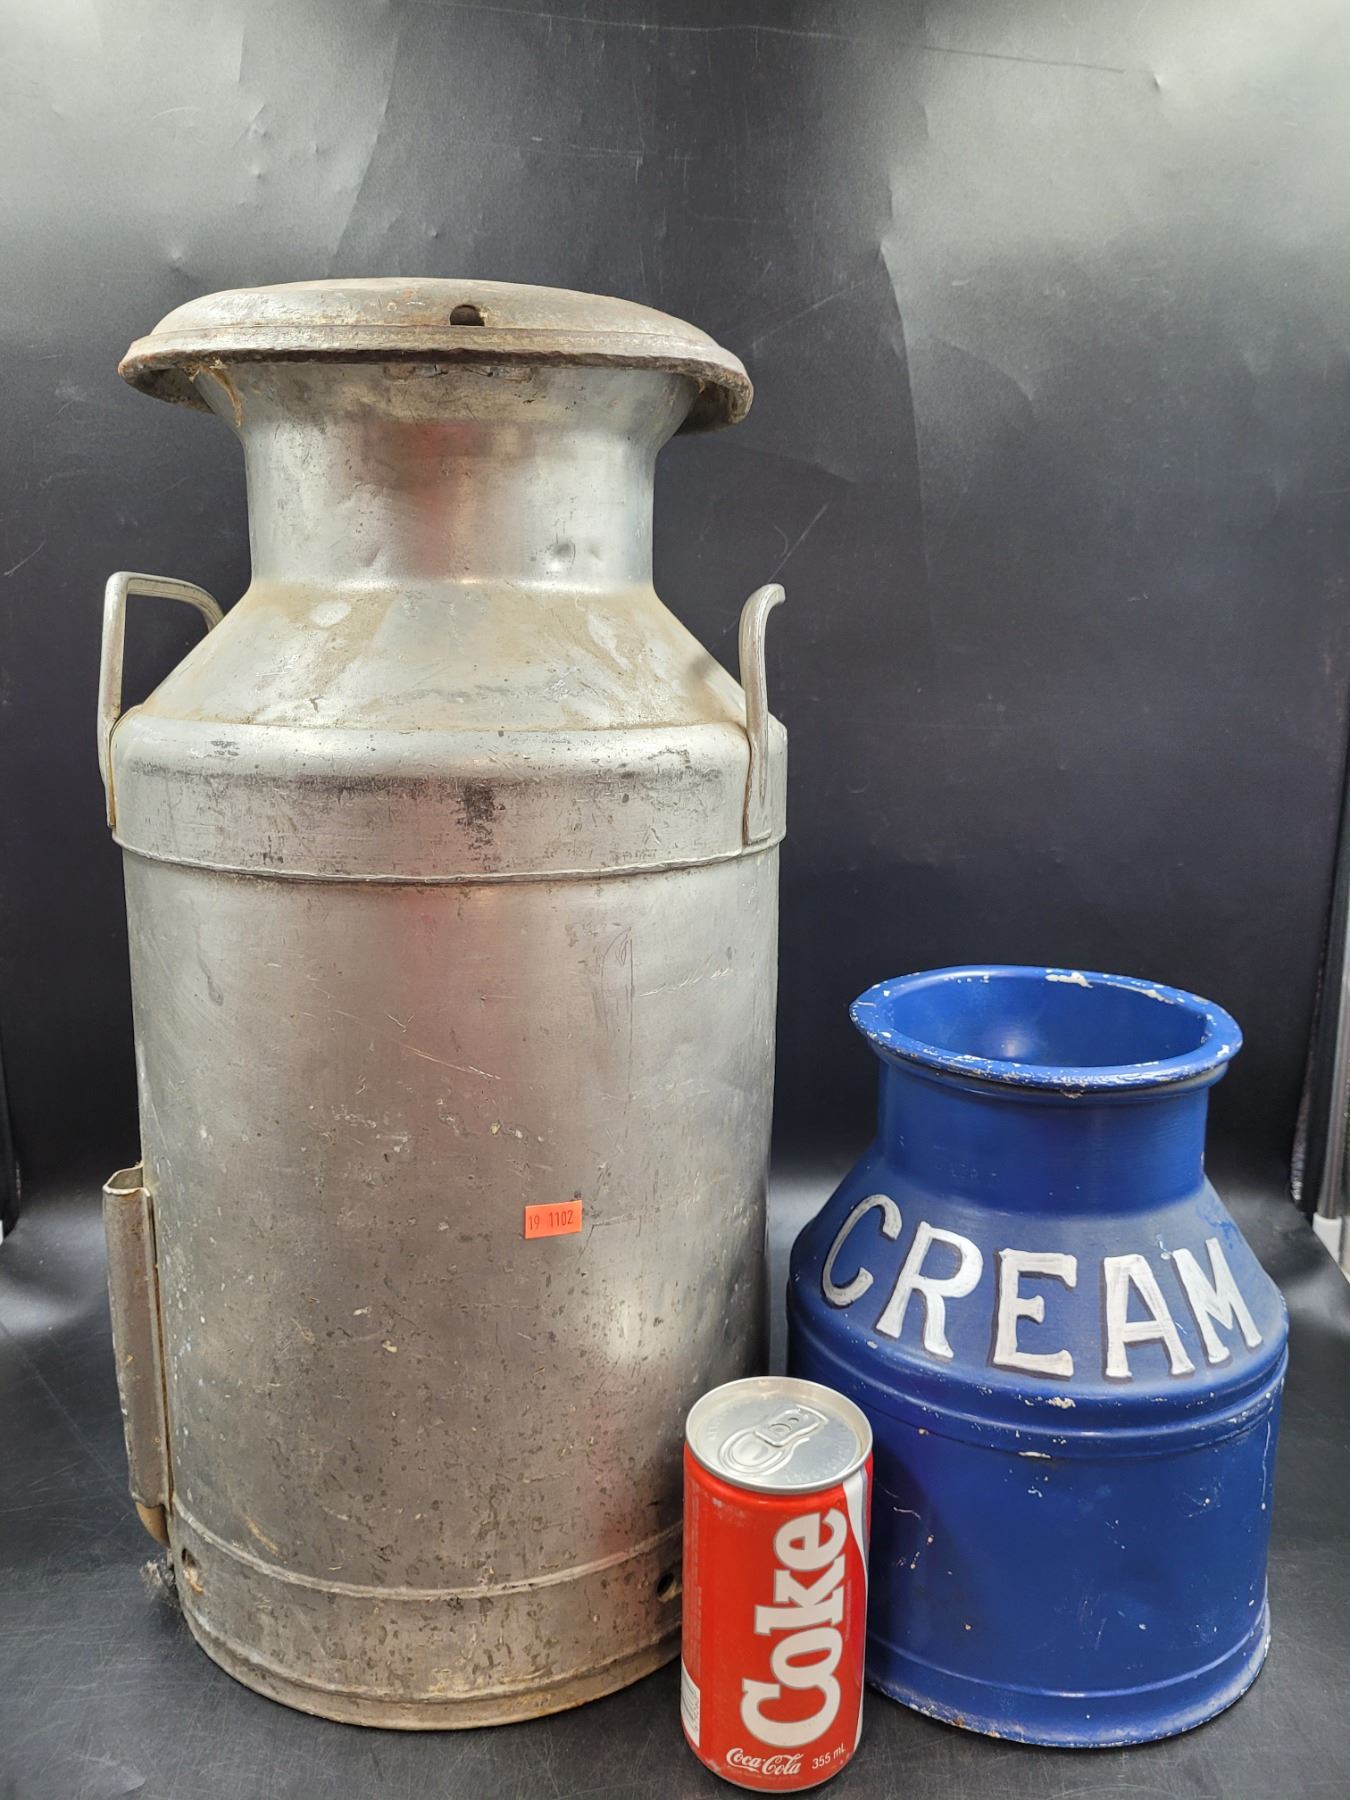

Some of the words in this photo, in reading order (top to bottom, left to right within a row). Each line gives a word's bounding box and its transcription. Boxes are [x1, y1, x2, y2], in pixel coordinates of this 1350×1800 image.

[528, 1214, 541, 1231] 19
[548, 1209, 575, 1228] 1102
[822, 1193, 1263, 1379] CREAM
[739, 1507, 848, 1749] Coke
[726, 1747, 804, 1776] Coca-Cola
[811, 1752, 831, 1770] 355
[833, 1743, 846, 1760] mL
